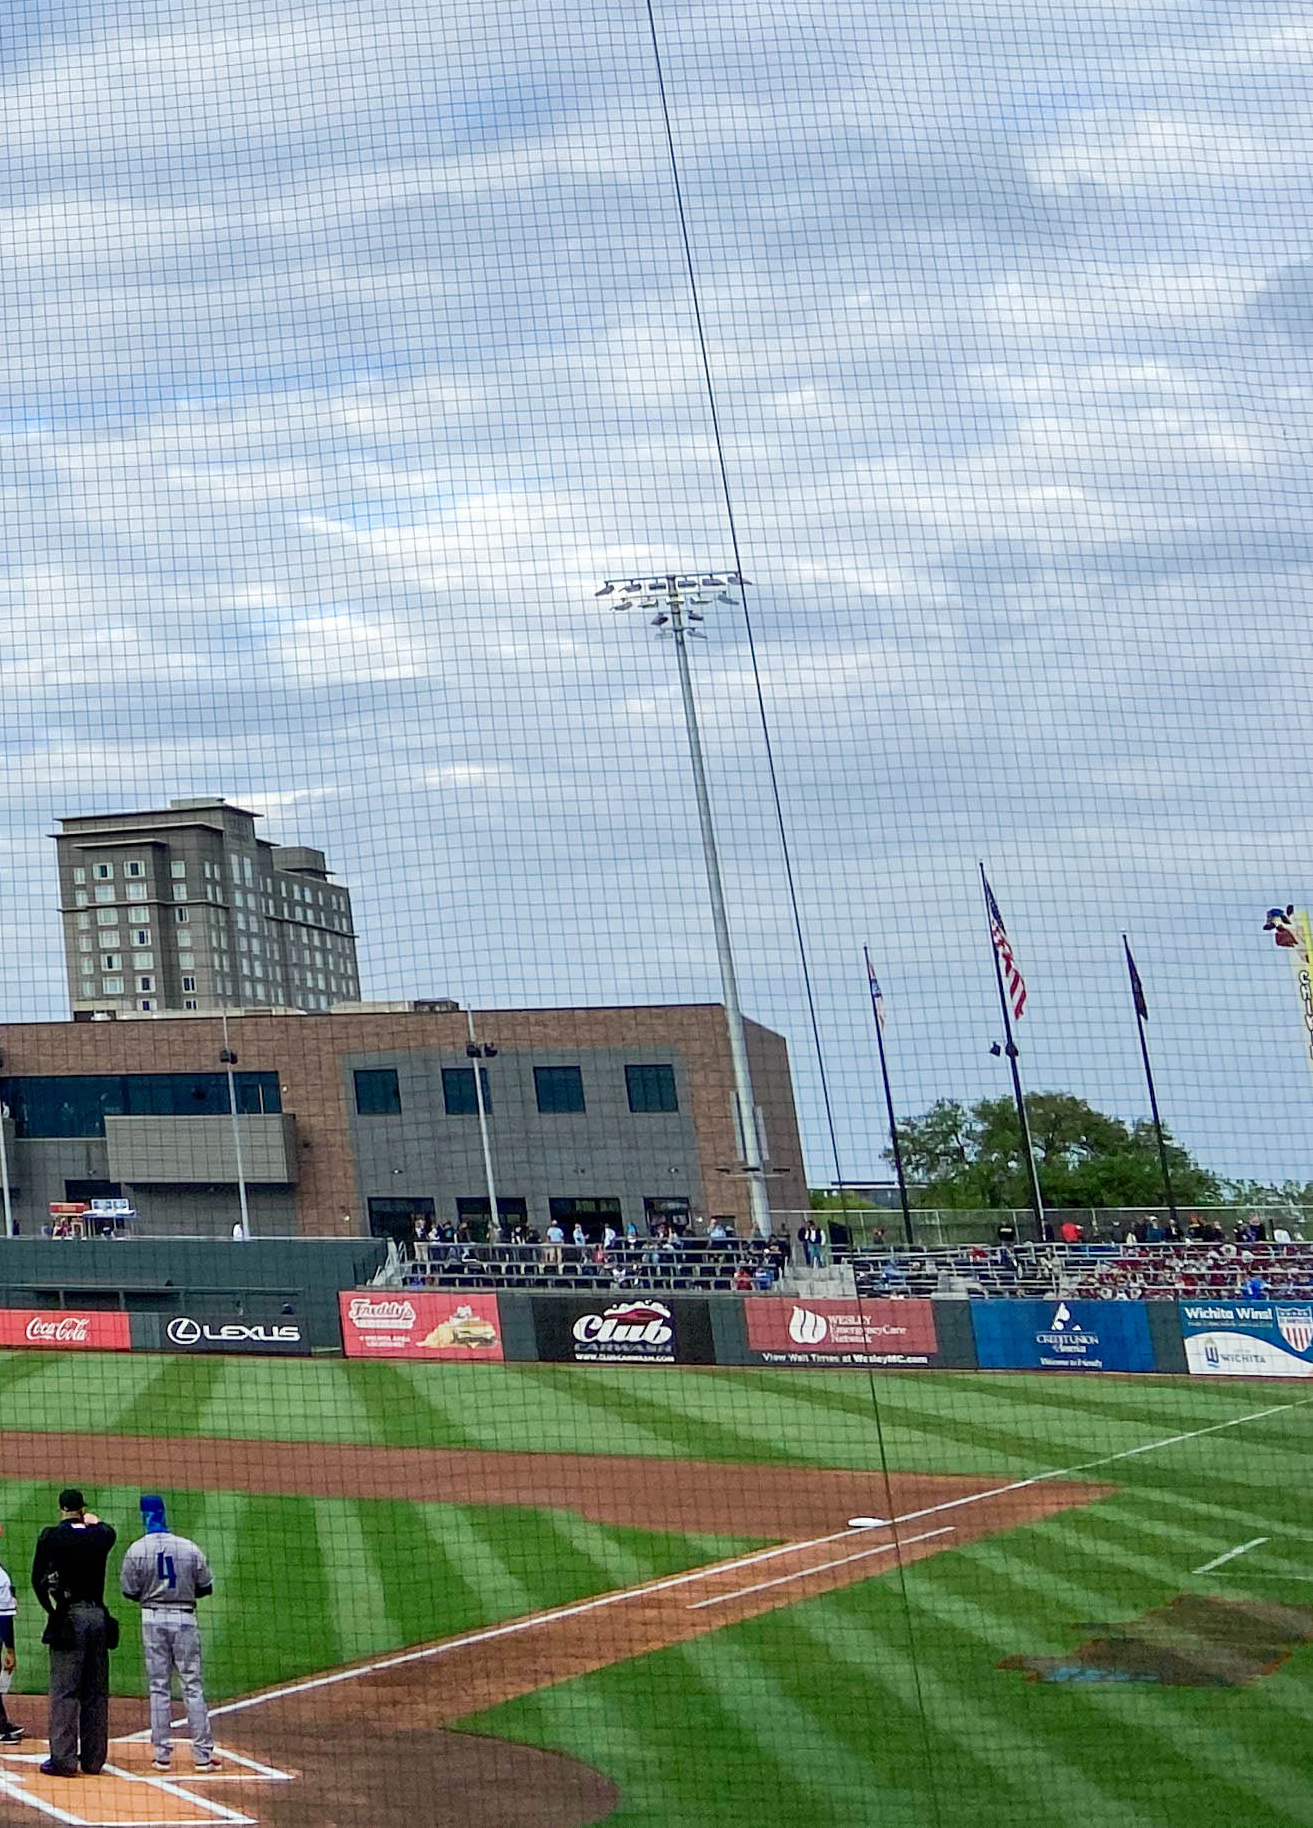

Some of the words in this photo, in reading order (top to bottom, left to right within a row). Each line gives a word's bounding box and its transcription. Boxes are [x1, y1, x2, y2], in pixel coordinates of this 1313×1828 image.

[828, 1315, 872, 1325] WESLEY
[1184, 1306, 1234, 1320] Wichita
[26, 1317, 90, 1342] Coca-Cola
[203, 1324, 301, 1342] LEXUS
[573, 1314, 673, 1344] Club
[1220, 1353, 1267, 1363] WICHITA
[157, 1551, 177, 1589] 4
